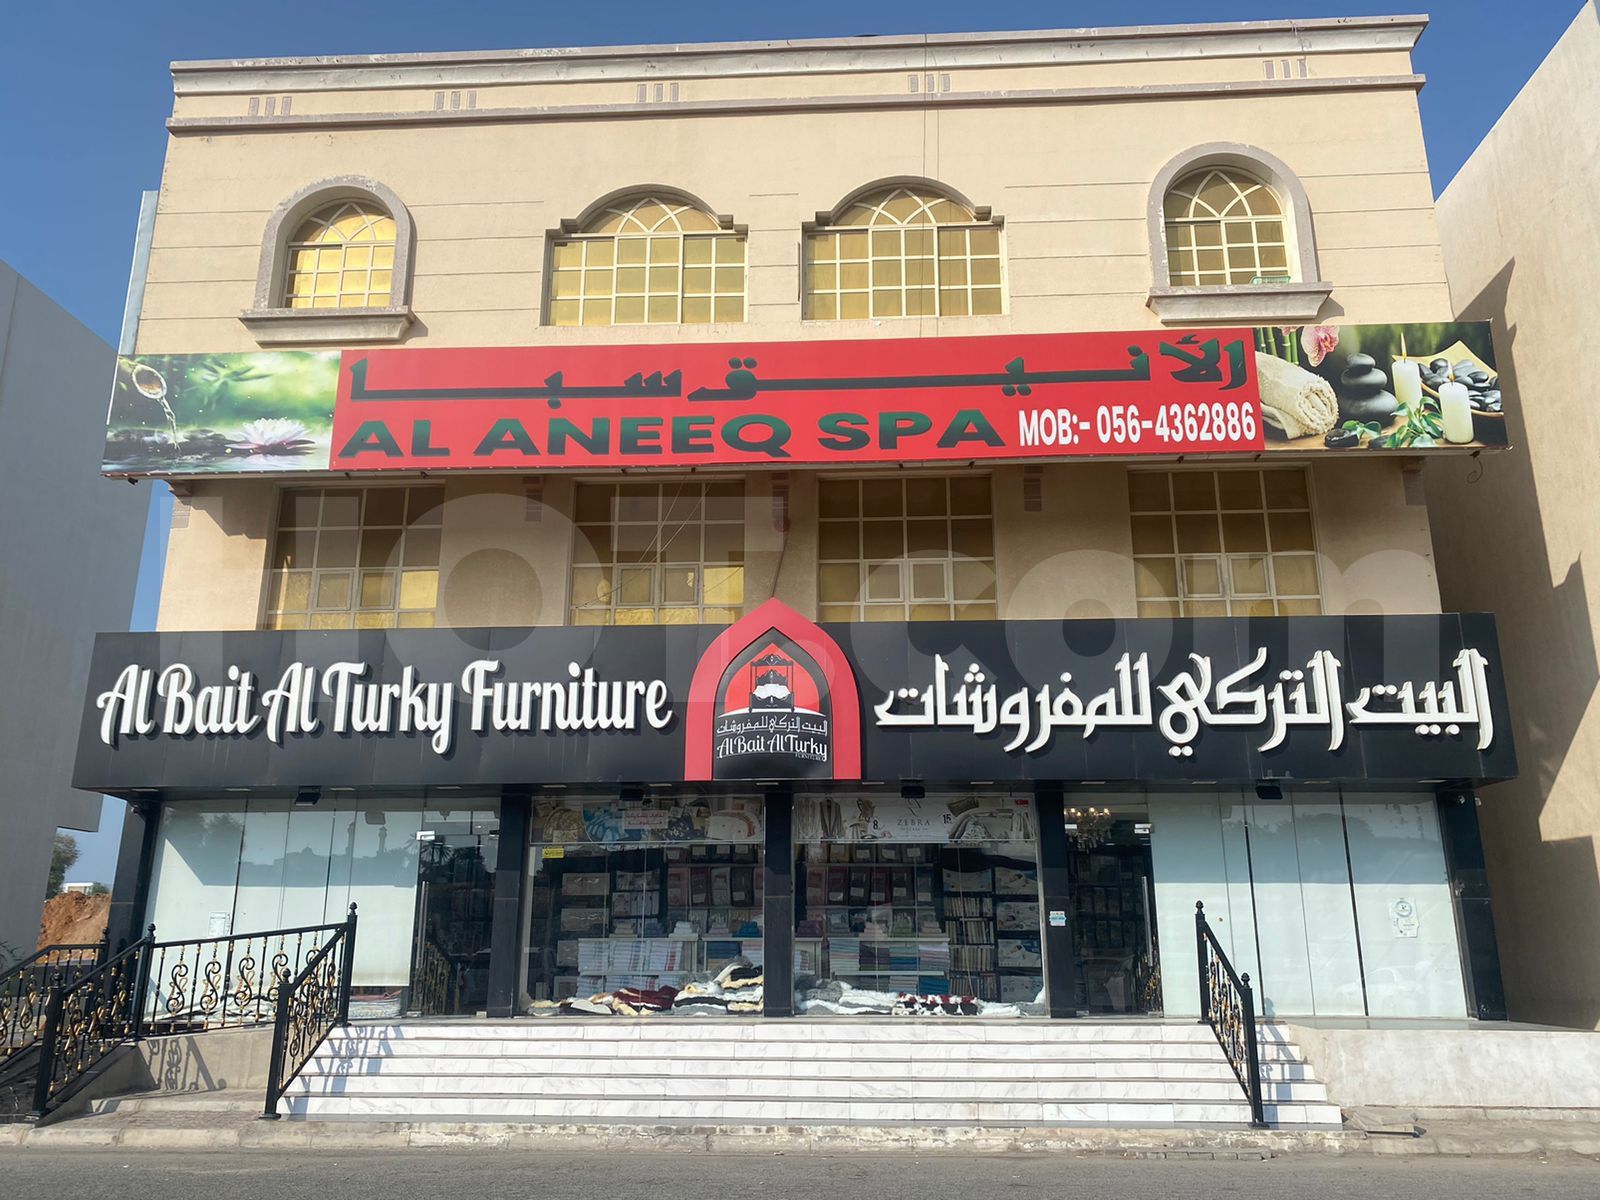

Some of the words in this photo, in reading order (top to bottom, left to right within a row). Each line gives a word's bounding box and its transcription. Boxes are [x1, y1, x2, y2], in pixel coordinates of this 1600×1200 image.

[350, 357, 682, 410] سبا
[339, 419, 450, 458] AL
[473, 412, 792, 458] ANEEQ
[817, 409, 1006, 450] SPA
[1097, 401, 1257, 444] 056-4362886
[96, 663, 156, 746] Al
[156, 662, 262, 736] Bait
[261, 661, 319, 744] Al
[321, 661, 454, 755] Turky
[461, 658, 674, 732] Furniture
[873, 650, 1154, 754] للمفروشات
[1156, 646, 1344, 758] التركي
[1347, 647, 1494, 752] البيت
[716, 737, 734, 759] Al
[734, 735, 765, 753] Bait
[766, 733, 784, 754] Al
[784, 734, 829, 762] Turky
[802, 719, 828, 737] البيت
[872, 819, 879, 831] 8
[897, 819, 931, 827] ZEBRA
